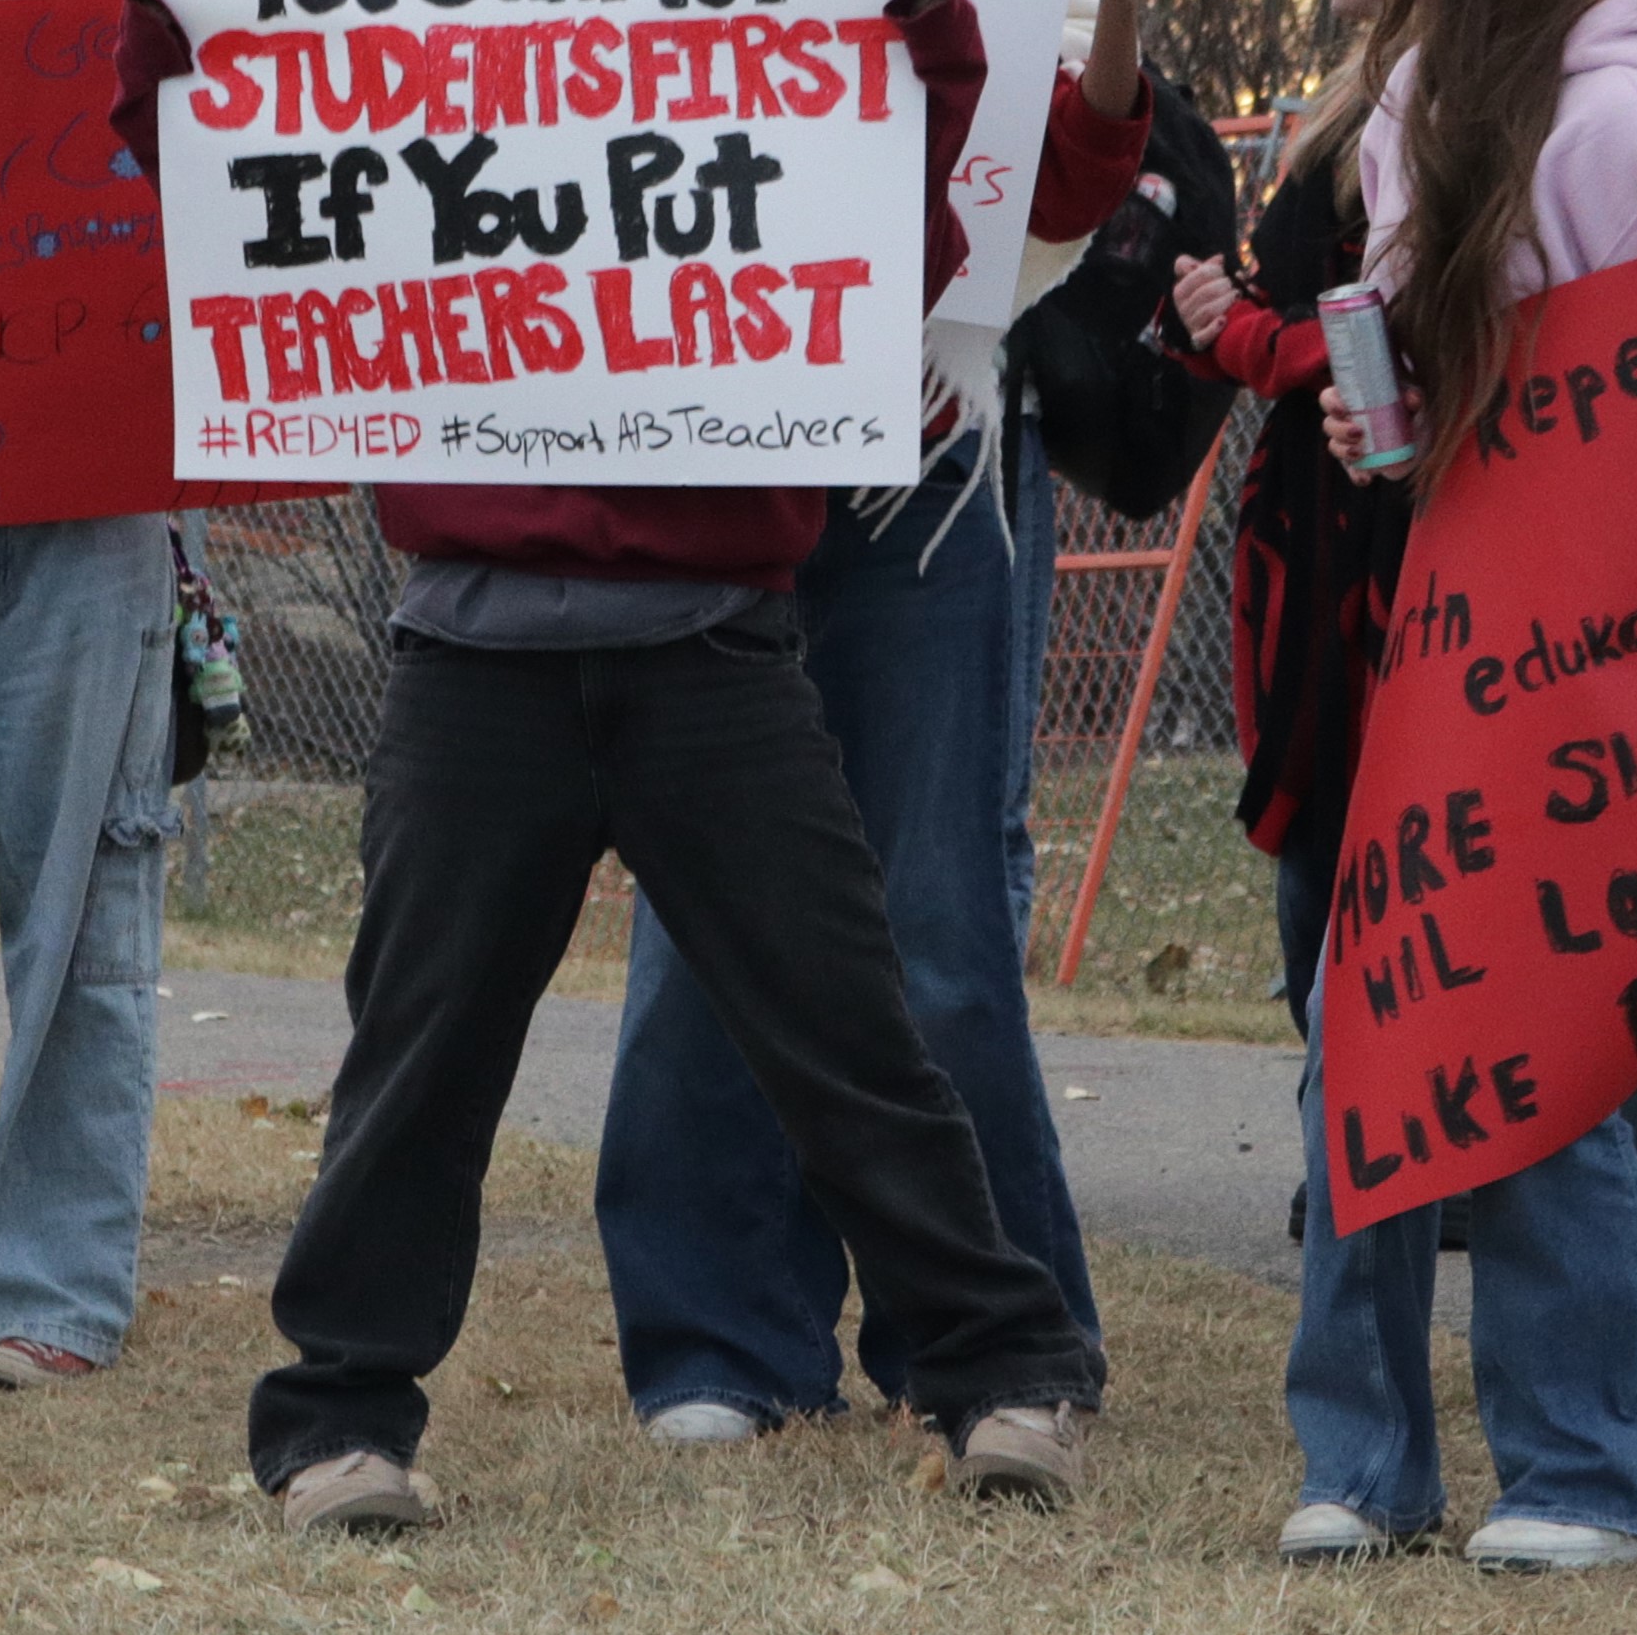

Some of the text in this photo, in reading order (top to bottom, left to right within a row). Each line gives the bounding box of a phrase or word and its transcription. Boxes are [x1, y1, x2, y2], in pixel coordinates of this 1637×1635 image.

[24, 11, 119, 79] Gre
[188, 14, 906, 136] STUDENTS FIRST
[229, 145, 390, 268] If
[397, 132, 588, 264] You
[605, 130, 783, 263] Put
[190, 262, 585, 404] TEACHERS
[588, 256, 873, 375] LAST
[197, 409, 421, 460] #RED4ED
[1334, 788, 1496, 965] MORE
[1364, 912, 1486, 1028] WIL
[1343, 1052, 1540, 1191] LIKE
